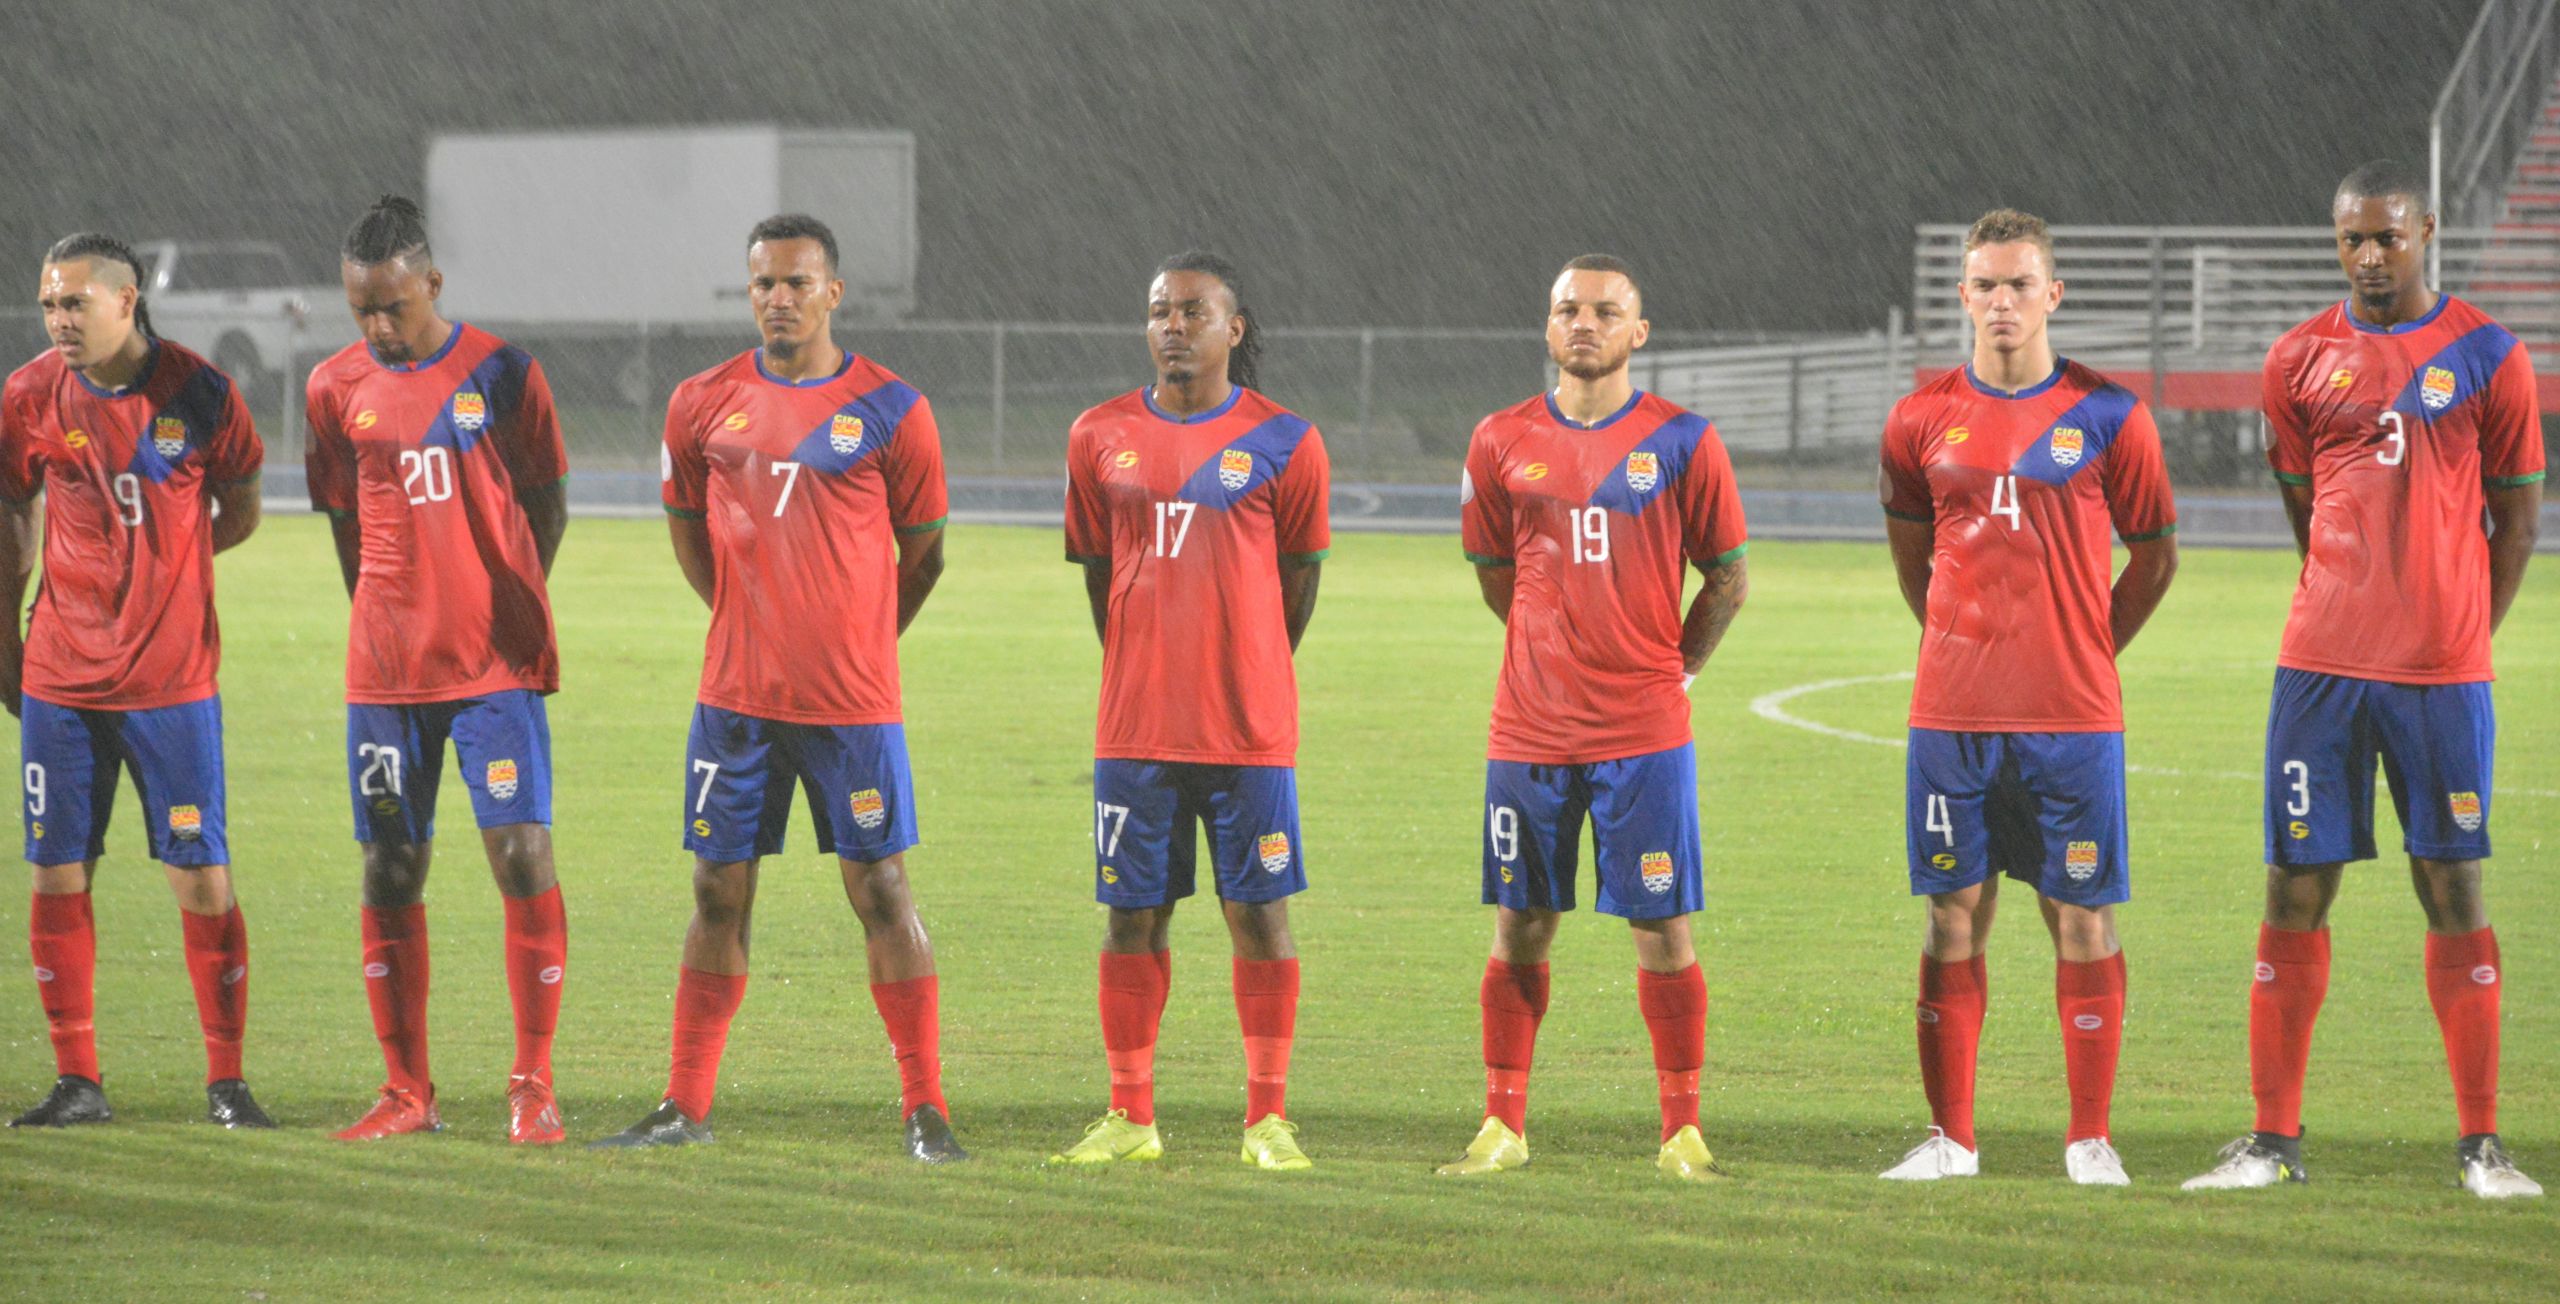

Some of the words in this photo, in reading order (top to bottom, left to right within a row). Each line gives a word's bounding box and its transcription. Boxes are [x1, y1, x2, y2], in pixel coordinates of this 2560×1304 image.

[455, 393, 484, 402] CIFA
[2428, 367, 2455, 380] CIFA
[834, 415, 863, 425] CIFA
[2055, 427, 2082, 438] CIFA
[2376, 411, 2405, 466] 3
[400, 446, 452, 506] 20
[1224, 450, 1251, 460] CIFA
[1629, 452, 1656, 461] CIFA
[114, 473, 142, 526] 9
[771, 461, 801, 517] 7
[1991, 475, 2020, 531] 4
[1154, 500, 1197, 558] 17
[1570, 505, 1609, 564] 19
[25, 763, 46, 816] 9
[488, 760, 515, 770] CIFA
[693, 758, 719, 813] 7
[2284, 760, 2309, 816] 3
[851, 788, 878, 801] CIFA
[1926, 794, 1953, 847] 4
[1096, 801, 1129, 857] 17
[1260, 832, 1286, 845] CIFA
[1489, 803, 1518, 861] 19
[2069, 842, 2096, 850] CIFA
[1642, 852, 1669, 862] CIFA
